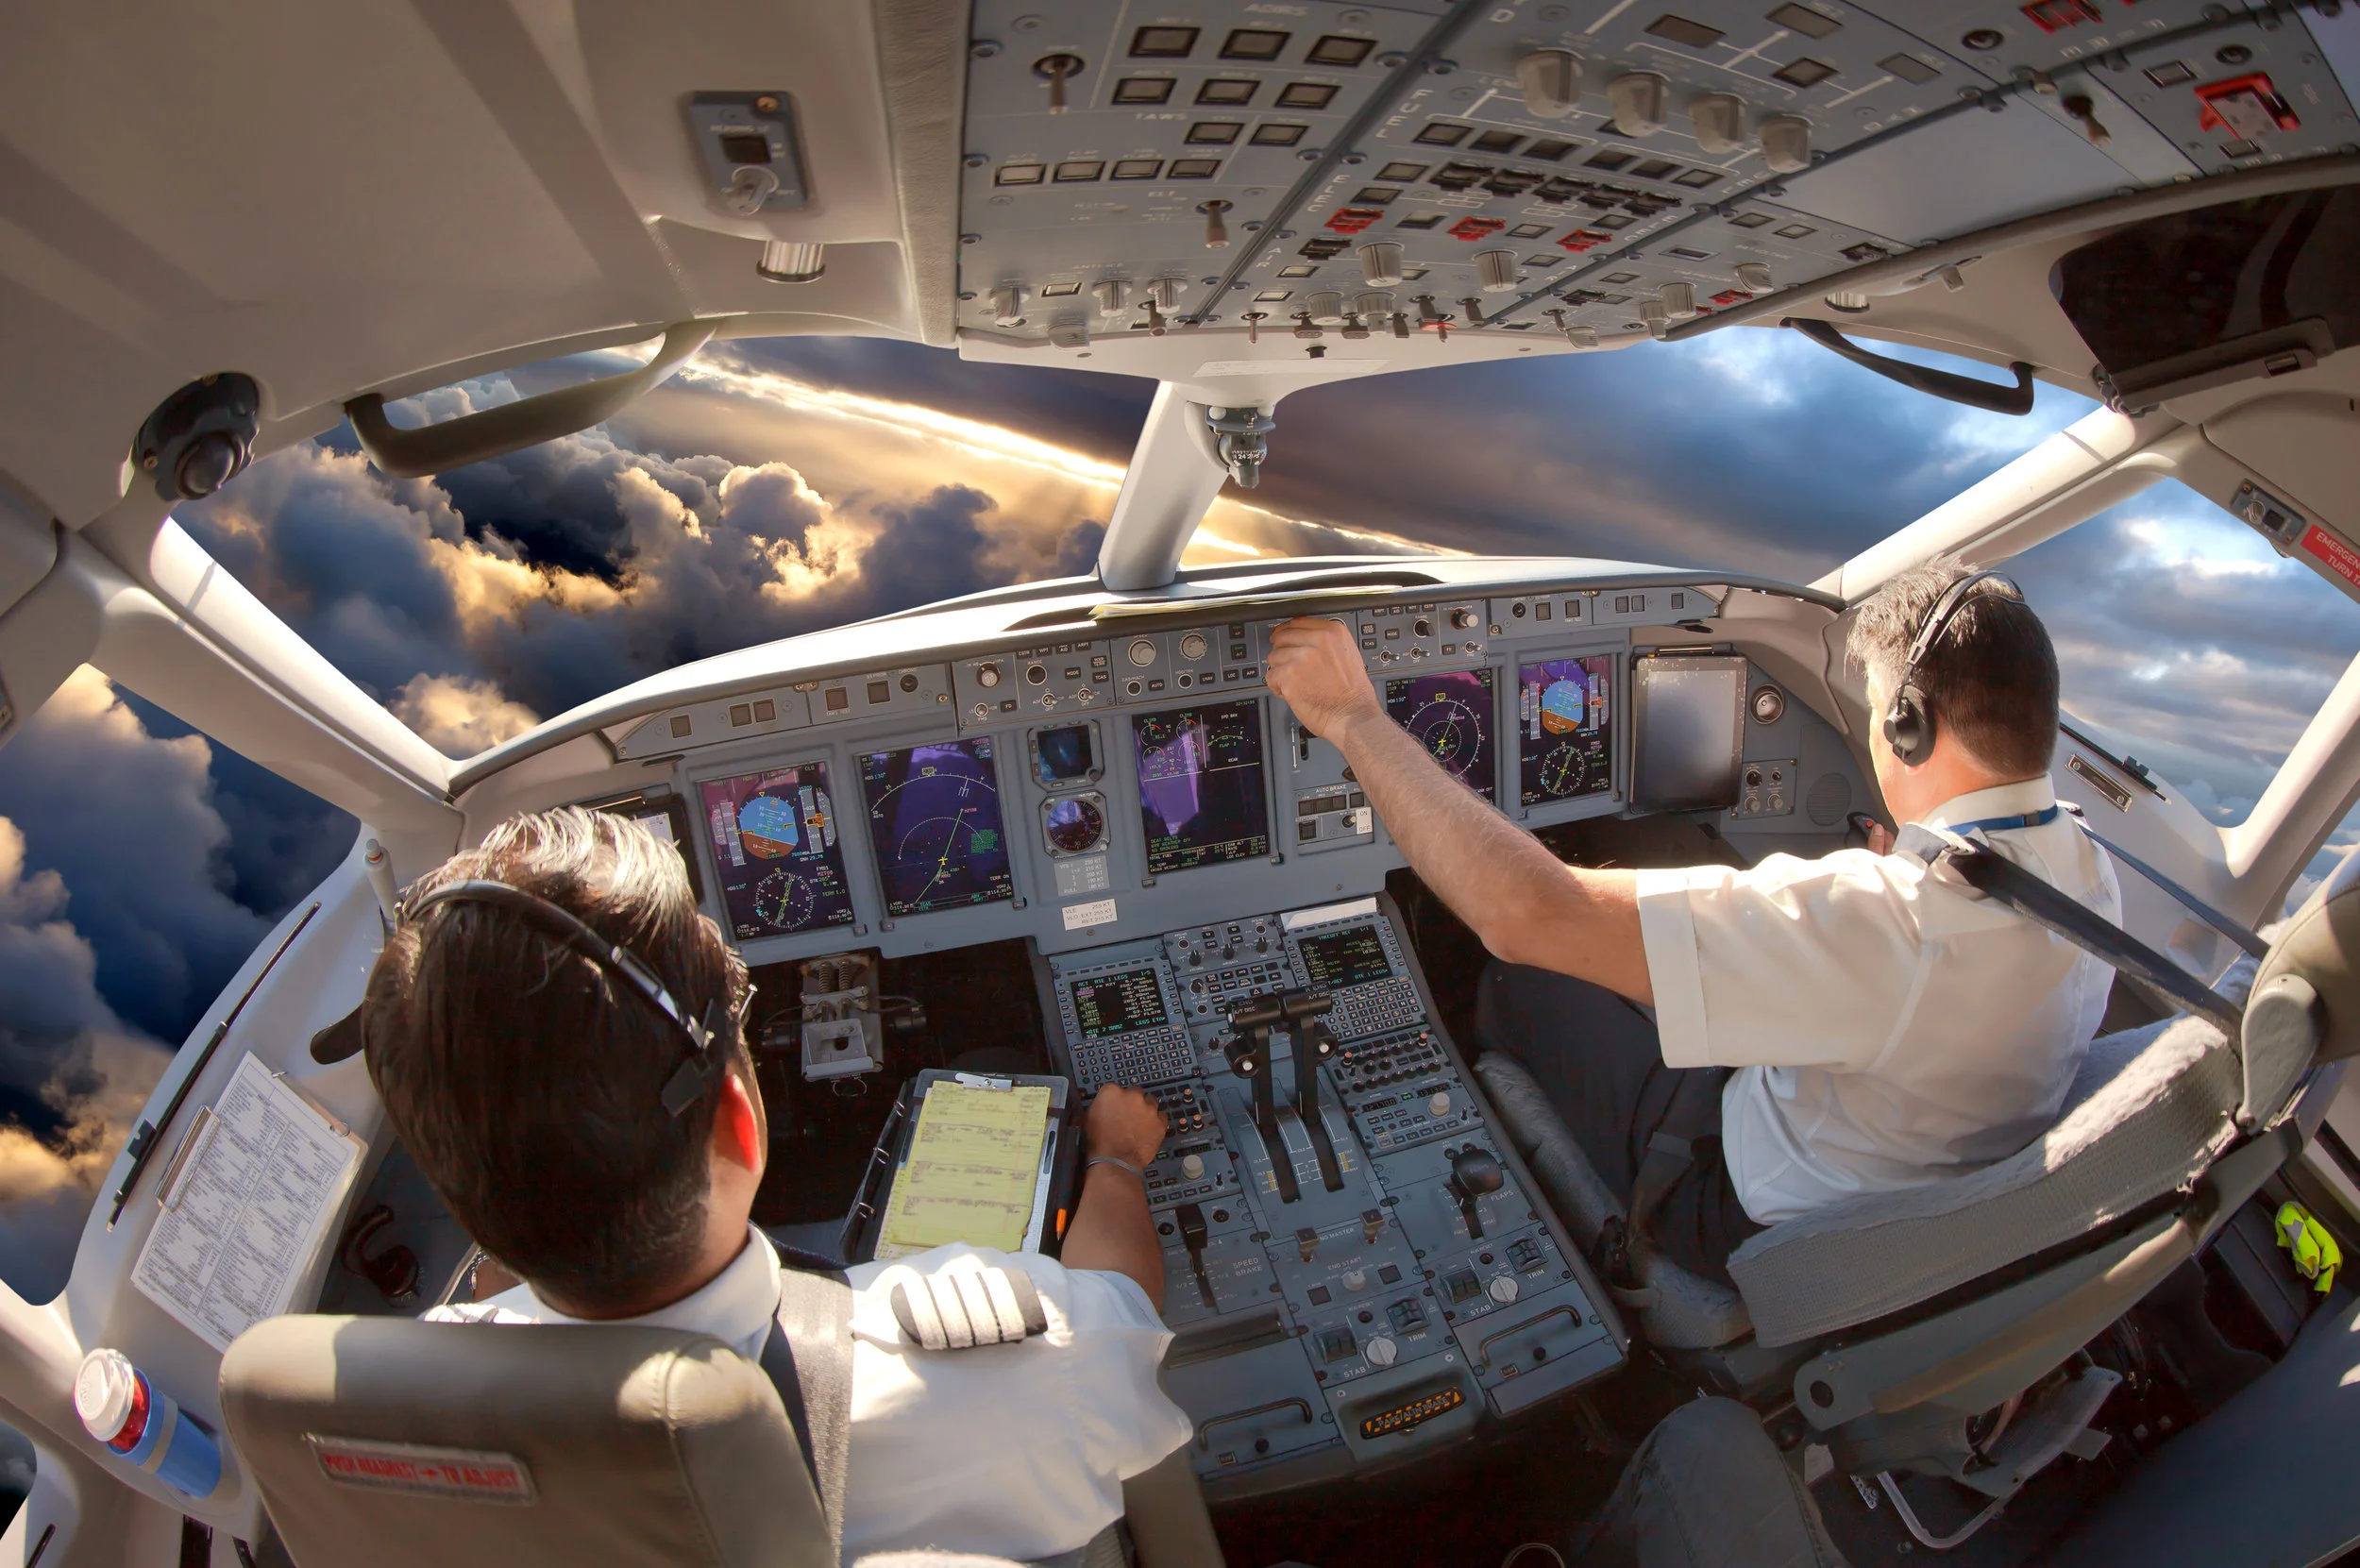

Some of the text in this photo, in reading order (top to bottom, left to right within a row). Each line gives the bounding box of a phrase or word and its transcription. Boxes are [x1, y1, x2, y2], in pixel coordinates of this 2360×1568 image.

[2328, 555, 2353, 578] TURN
[1491, 1189, 1514, 1201] FLAPS
[1329, 1227, 1355, 1238] MASTER
[1233, 1257, 1258, 1269] SPEED
[1343, 1257, 1361, 1267] START
[1236, 1266, 1262, 1276] BRAKE
[1527, 1269, 1545, 1279] TRIM
[1470, 1305, 1492, 1316] STAB
[1408, 1333, 1426, 1343] TRIM
[1343, 1366, 1367, 1378] STAB
[1424, 1397, 1449, 1411] BRAKE
[323, 1454, 357, 1473] PUSH
[441, 1466, 462, 1485] TO
[462, 1467, 518, 1488] ADJUST
